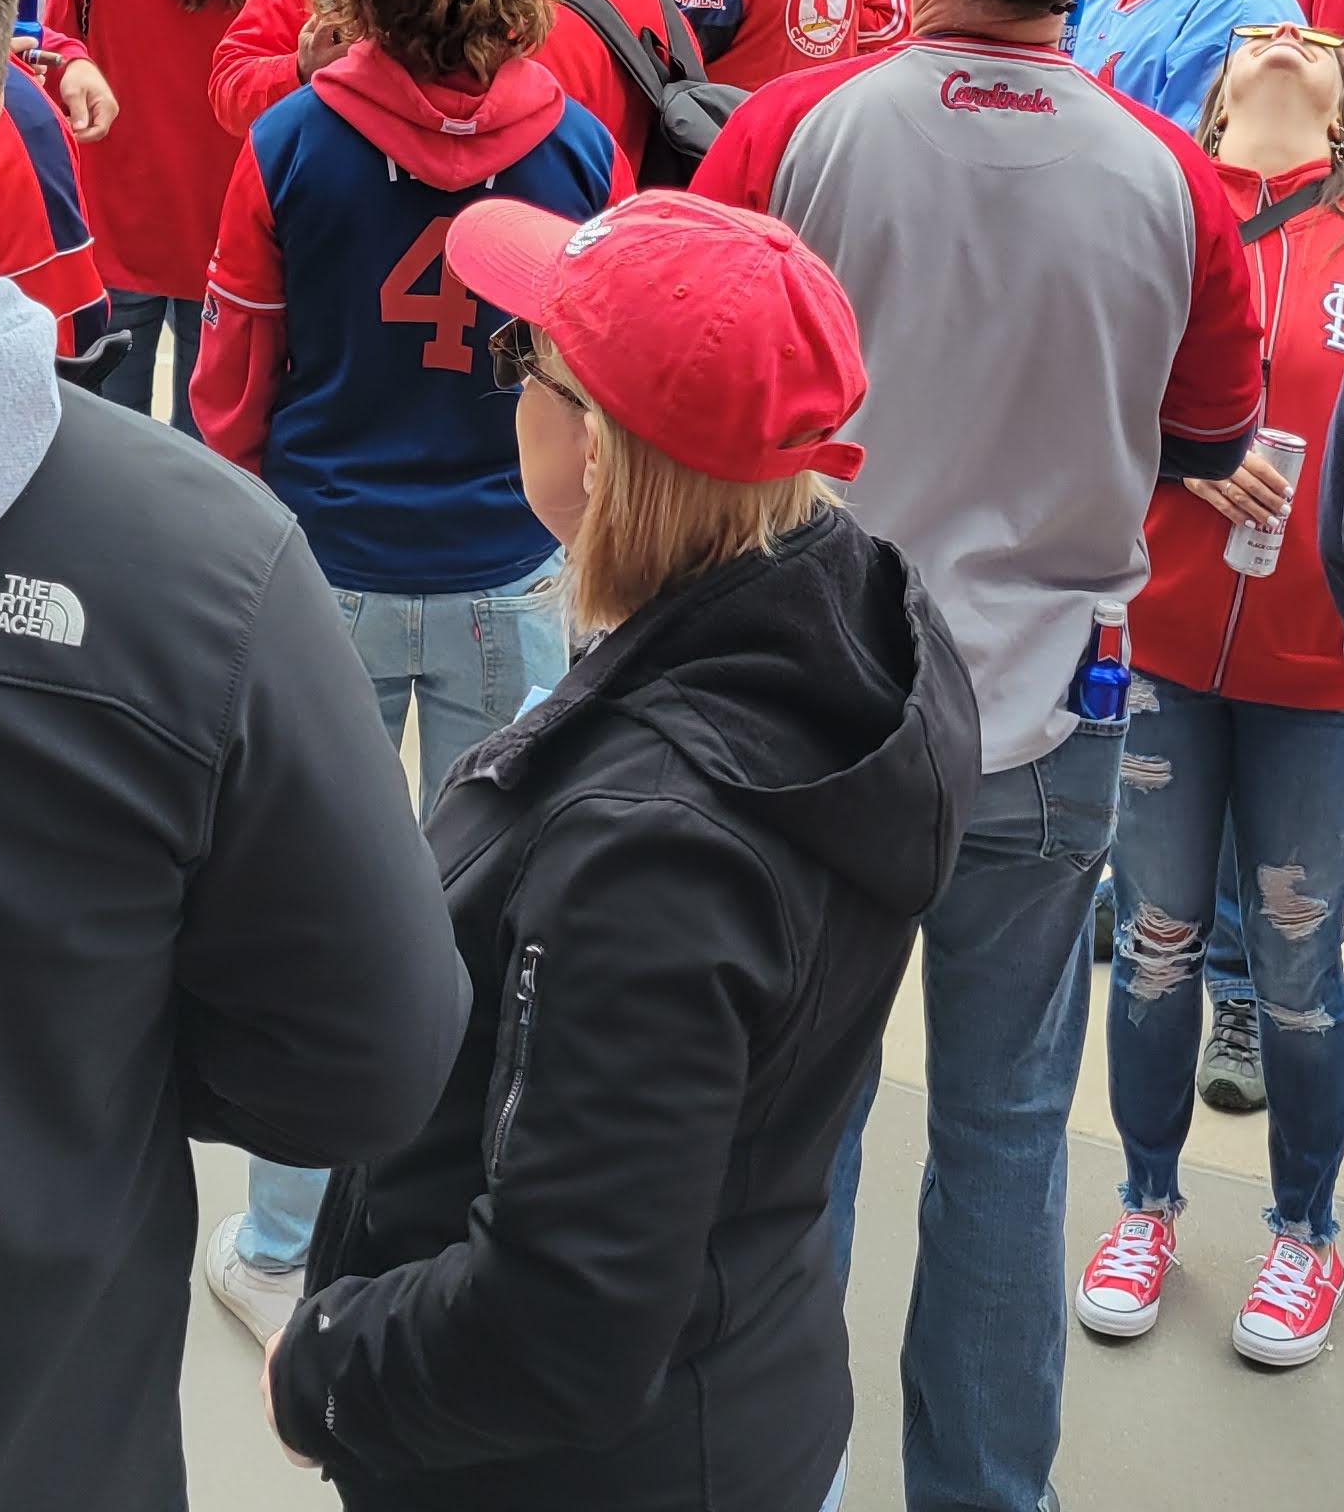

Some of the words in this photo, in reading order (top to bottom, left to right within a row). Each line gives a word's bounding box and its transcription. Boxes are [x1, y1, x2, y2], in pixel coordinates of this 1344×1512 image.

[790, 18, 850, 55] CARDINALS
[940, 69, 1058, 116] Cardinals
[380, 216, 478, 375] 4
[4, 574, 51, 600] THE
